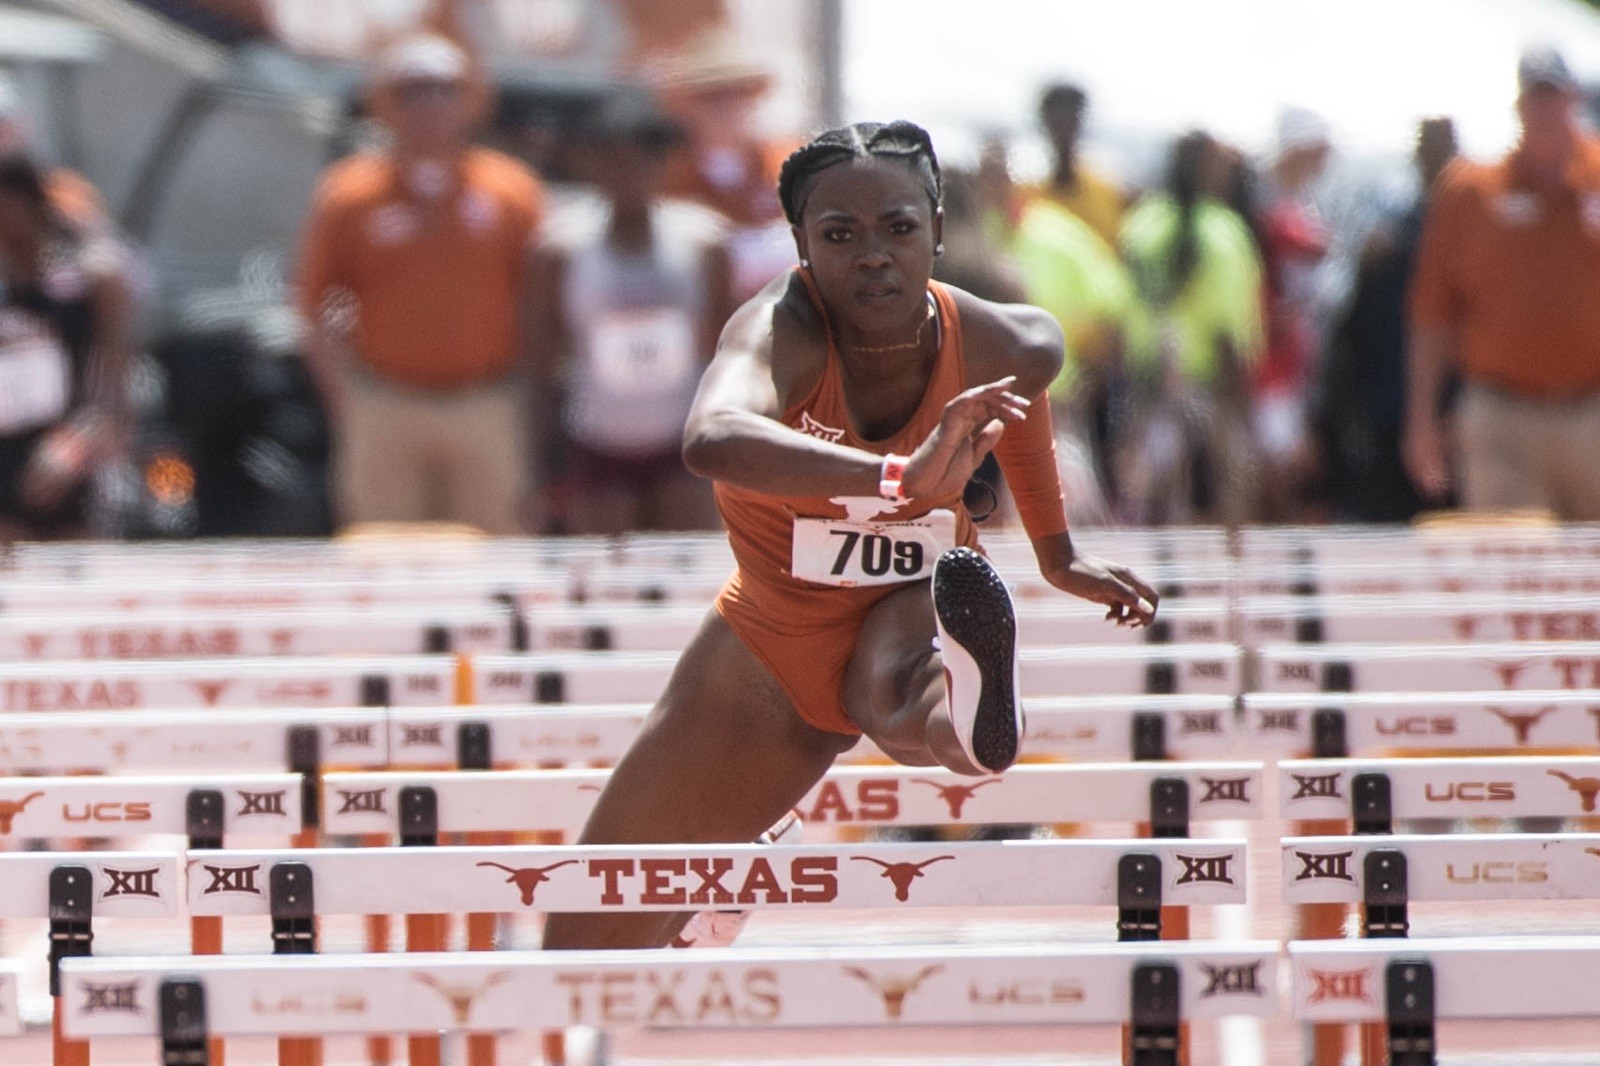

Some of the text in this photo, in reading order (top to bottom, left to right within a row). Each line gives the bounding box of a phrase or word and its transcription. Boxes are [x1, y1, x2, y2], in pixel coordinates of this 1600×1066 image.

[829, 530, 923, 576] 709
[1375, 716, 1456, 735] UCS
[337, 788, 387, 815] XII
[1200, 777, 1251, 803] XII
[1291, 772, 1341, 800] XII
[1425, 782, 1516, 802] UCS
[62, 802, 152, 822] UCS
[237, 790, 287, 816] XII
[203, 864, 261, 895] XII
[588, 856, 838, 905] TEXAS
[1175, 854, 1234, 885] XII
[1295, 850, 1353, 882] XII
[1447, 862, 1548, 884] UCS
[102, 867, 161, 898] XII
[555, 968, 781, 1022] TEXAS
[1200, 961, 1264, 999] XII
[1307, 967, 1373, 1003] XII
